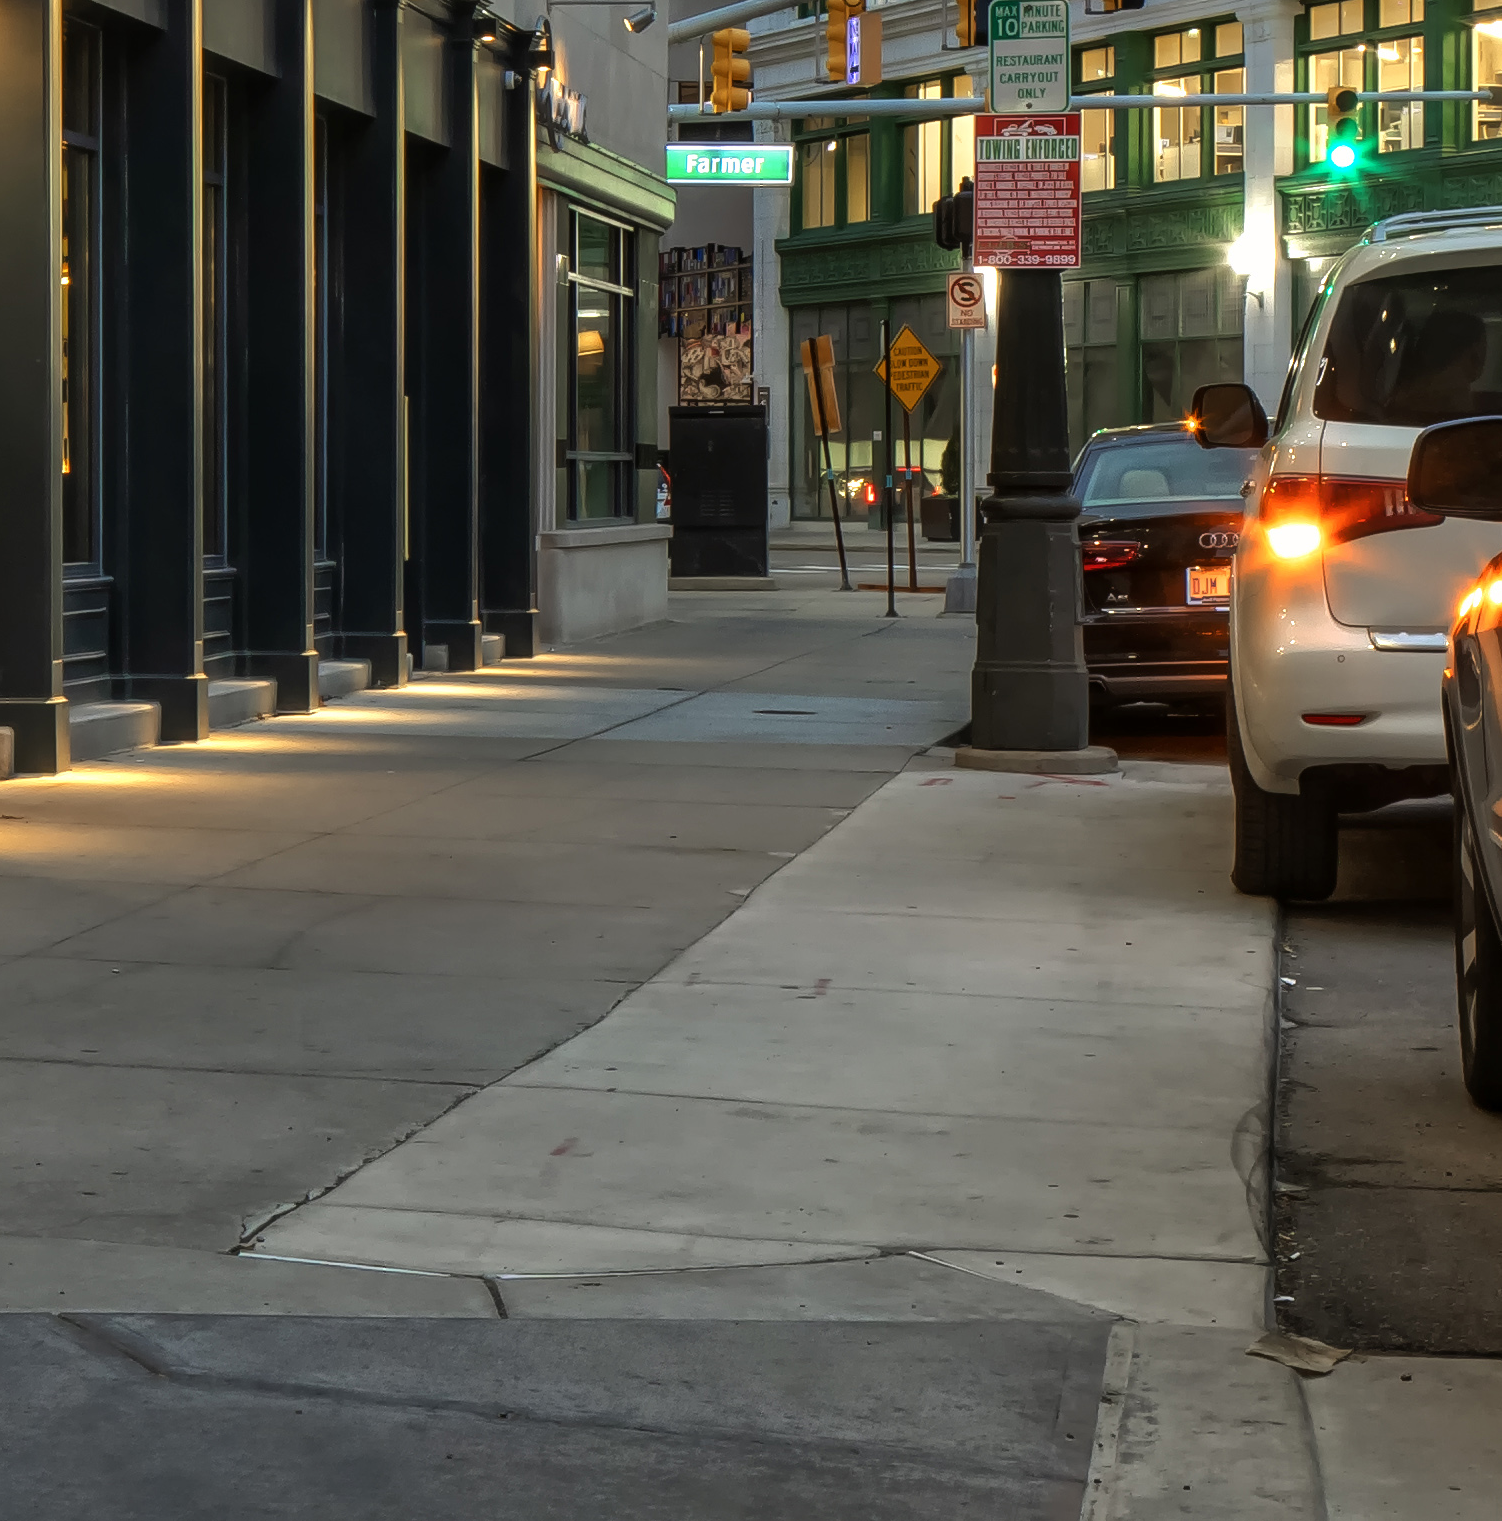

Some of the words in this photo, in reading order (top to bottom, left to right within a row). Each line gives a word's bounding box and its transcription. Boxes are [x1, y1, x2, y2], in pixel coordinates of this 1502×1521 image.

[995, 5, 1018, 17] MAX
[1023, 4, 1061, 17] MINUTE
[997, 19, 1018, 36] 10
[1021, 20, 1065, 34] PARKING
[996, 54, 1064, 67] RESTAURANT
[999, 72, 1059, 84] CARRYOUT
[1017, 88, 1046, 99] ONLY
[979, 139, 1021, 160] TOWING
[1025, 138, 1077, 160] ENFORCED
[685, 153, 765, 174] Farmer
[1192, 577, 1217, 595] DJM
